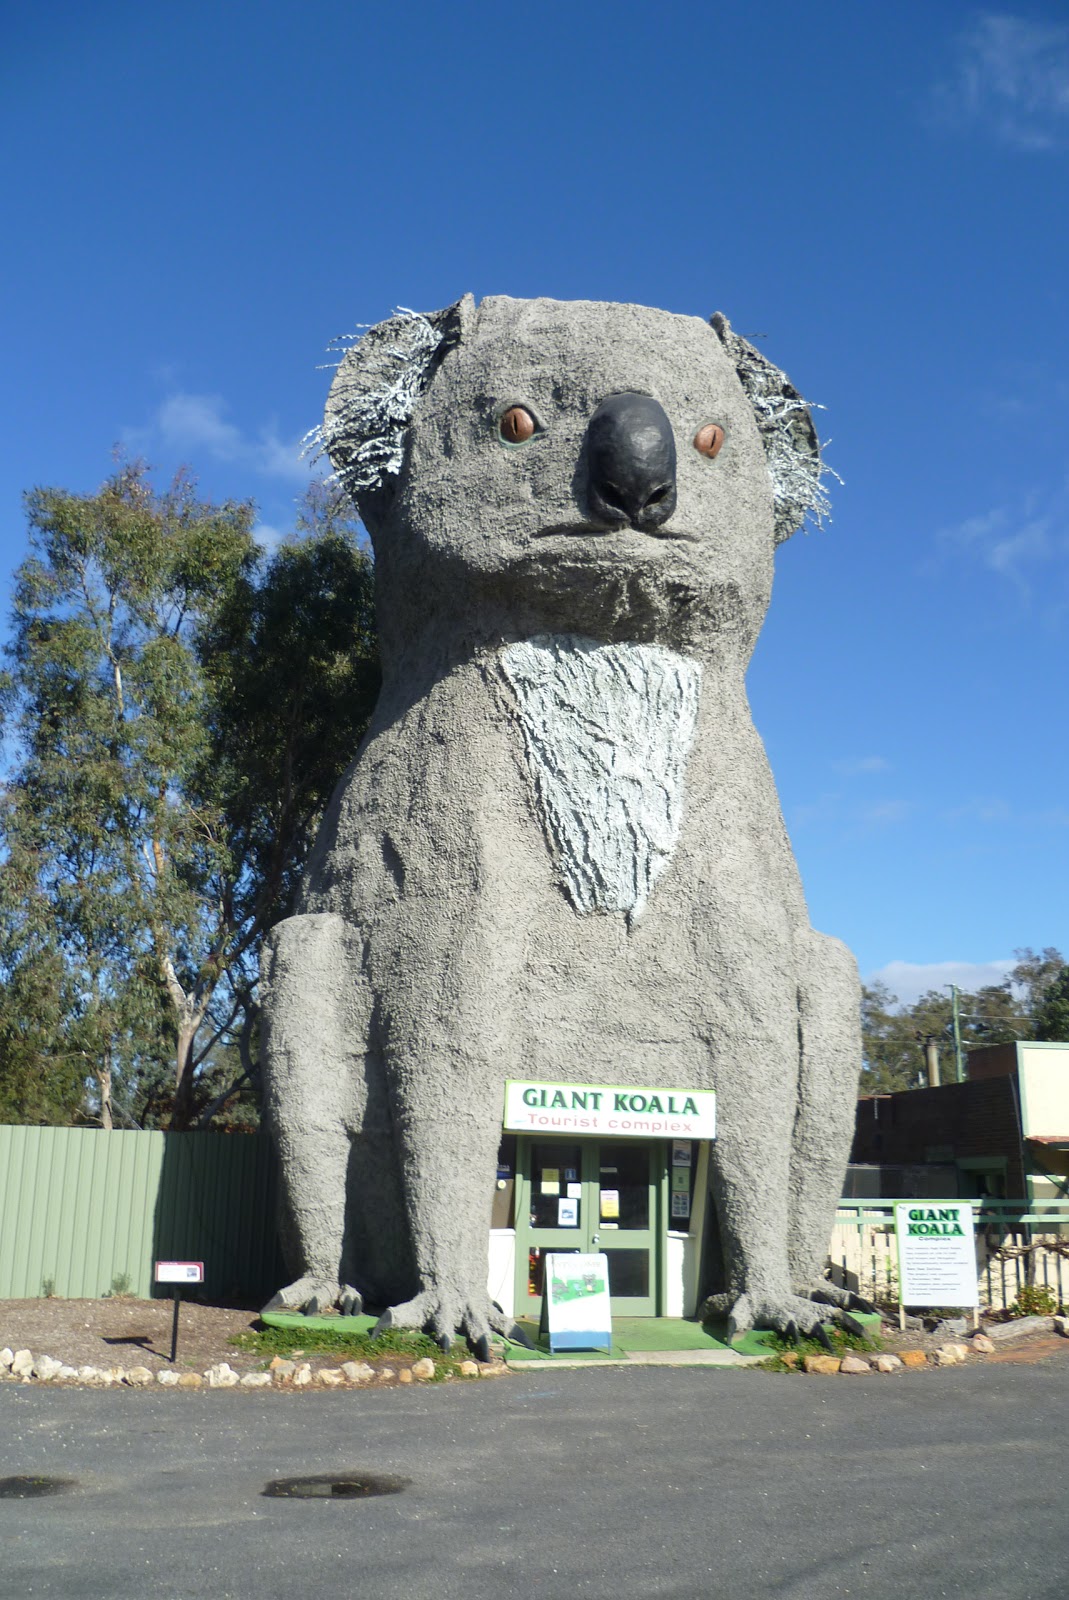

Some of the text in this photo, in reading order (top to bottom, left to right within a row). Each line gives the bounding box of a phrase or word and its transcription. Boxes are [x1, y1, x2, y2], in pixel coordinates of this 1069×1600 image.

[522, 1088, 699, 1116] GIANT KOALA
[527, 1113, 598, 1128] Tourist
[908, 1209, 960, 1221] GIANT
[907, 1223, 966, 1236] KOALA
